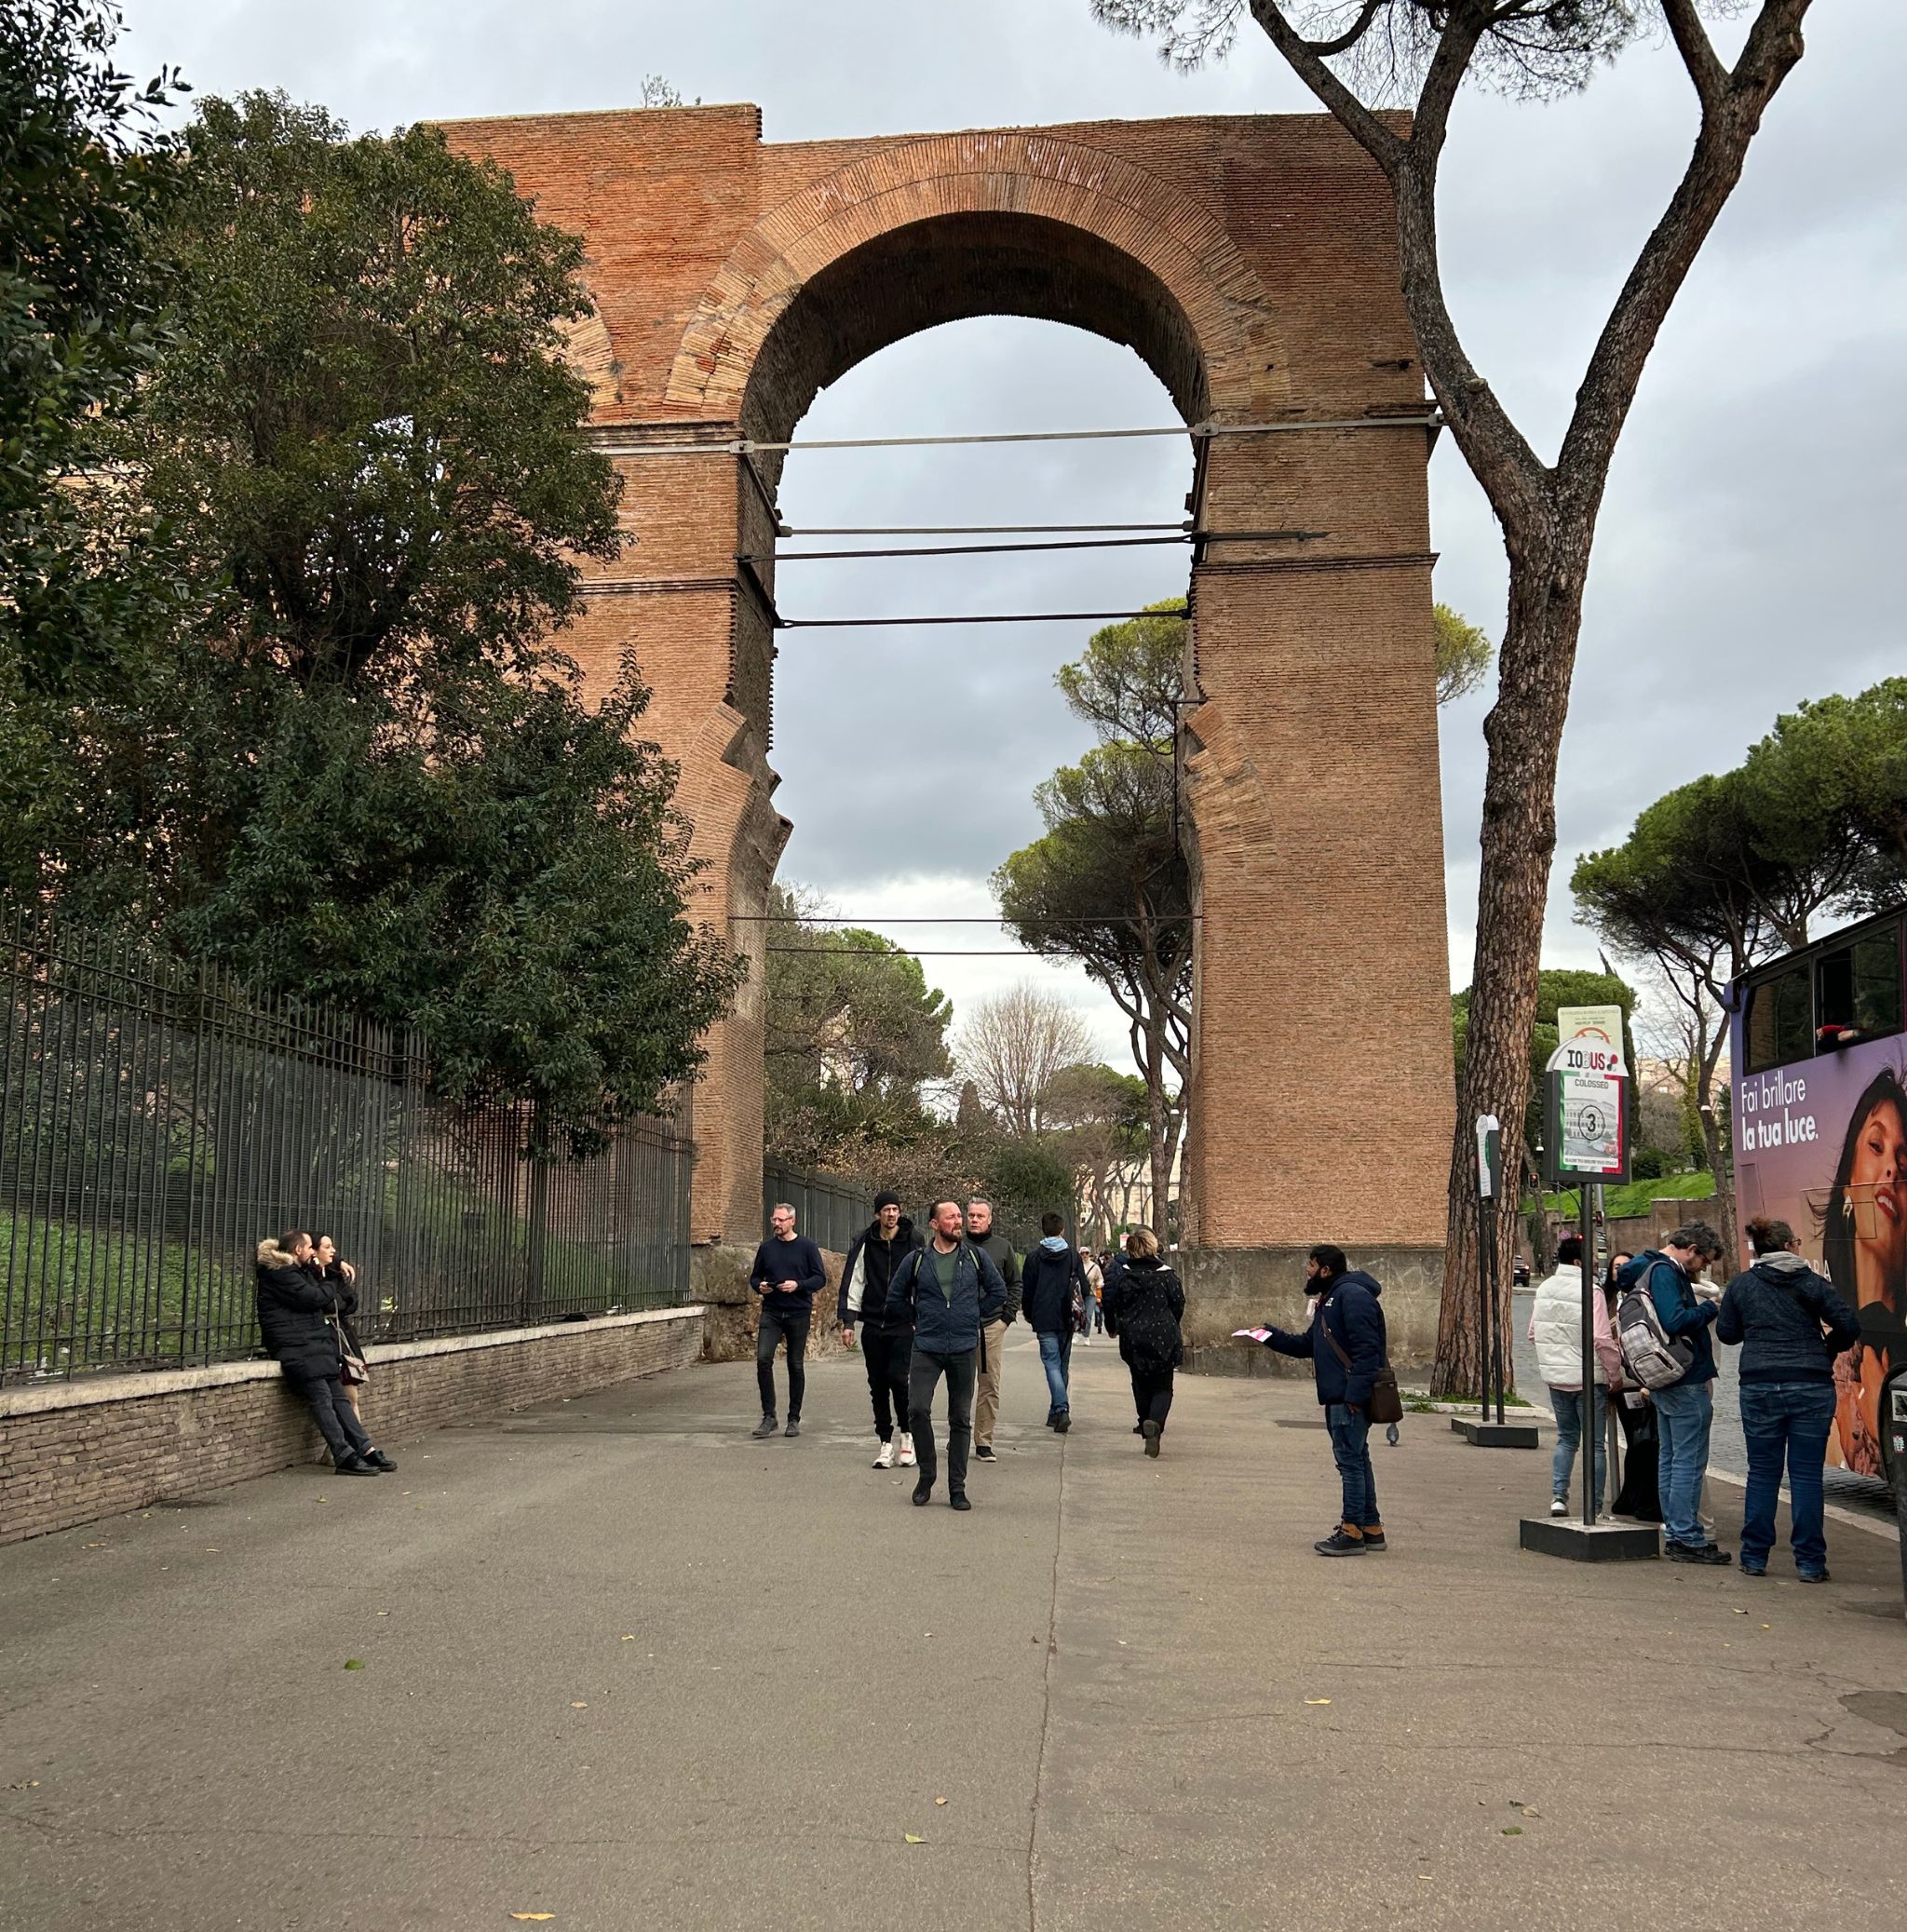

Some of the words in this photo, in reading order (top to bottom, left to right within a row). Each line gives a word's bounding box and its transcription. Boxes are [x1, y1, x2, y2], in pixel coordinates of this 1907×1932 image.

[1567, 1049, 1605, 1070] IOBUS
[1575, 1078, 1609, 1088] COLOSSEO
[1741, 1082, 1758, 1114] Fai
[1762, 1070, 1806, 1109] brillare
[1587, 1114, 1596, 1132] 3
[1742, 1116, 1755, 1151] la
[1758, 1119, 1782, 1148] tua
[1784, 1107, 1819, 1144] luce.
